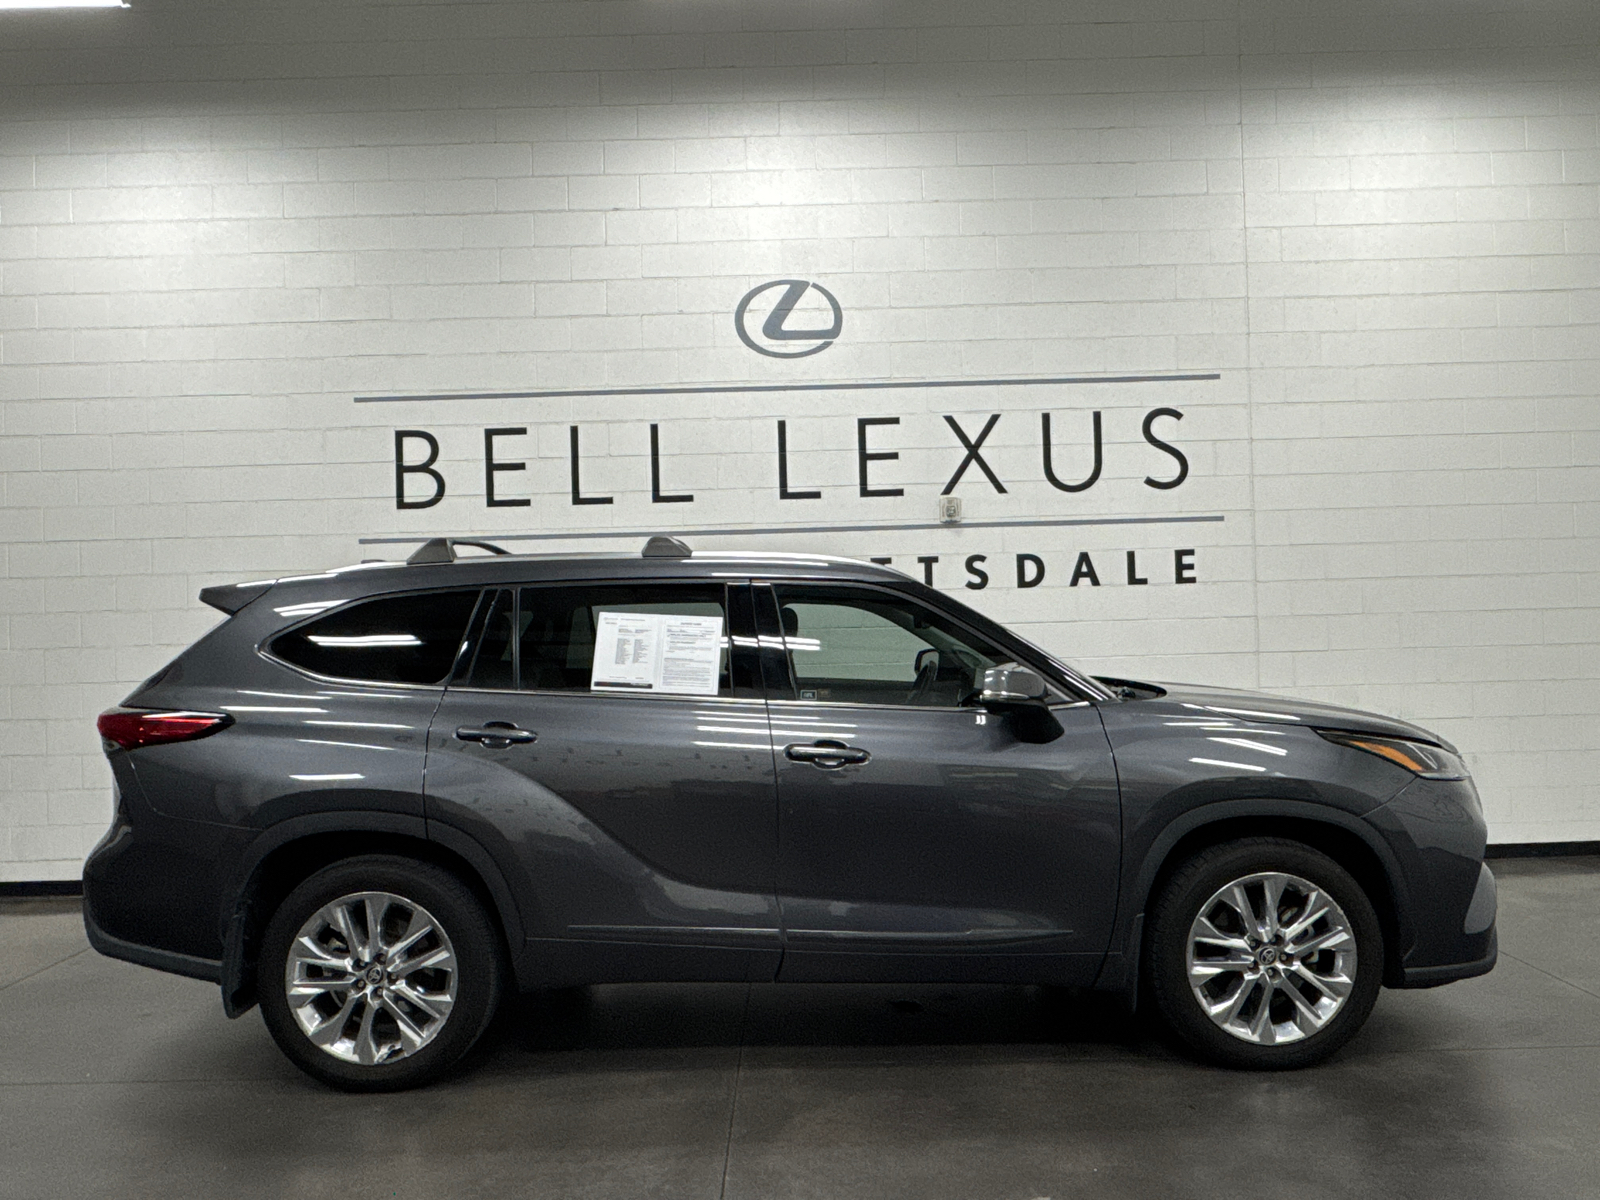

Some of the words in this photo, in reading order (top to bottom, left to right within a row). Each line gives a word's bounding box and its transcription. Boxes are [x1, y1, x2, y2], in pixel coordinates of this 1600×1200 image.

[395, 424, 694, 509] BELL
[777, 407, 1190, 500] LEXUS
[870, 548, 1197, 590] TSDALE
